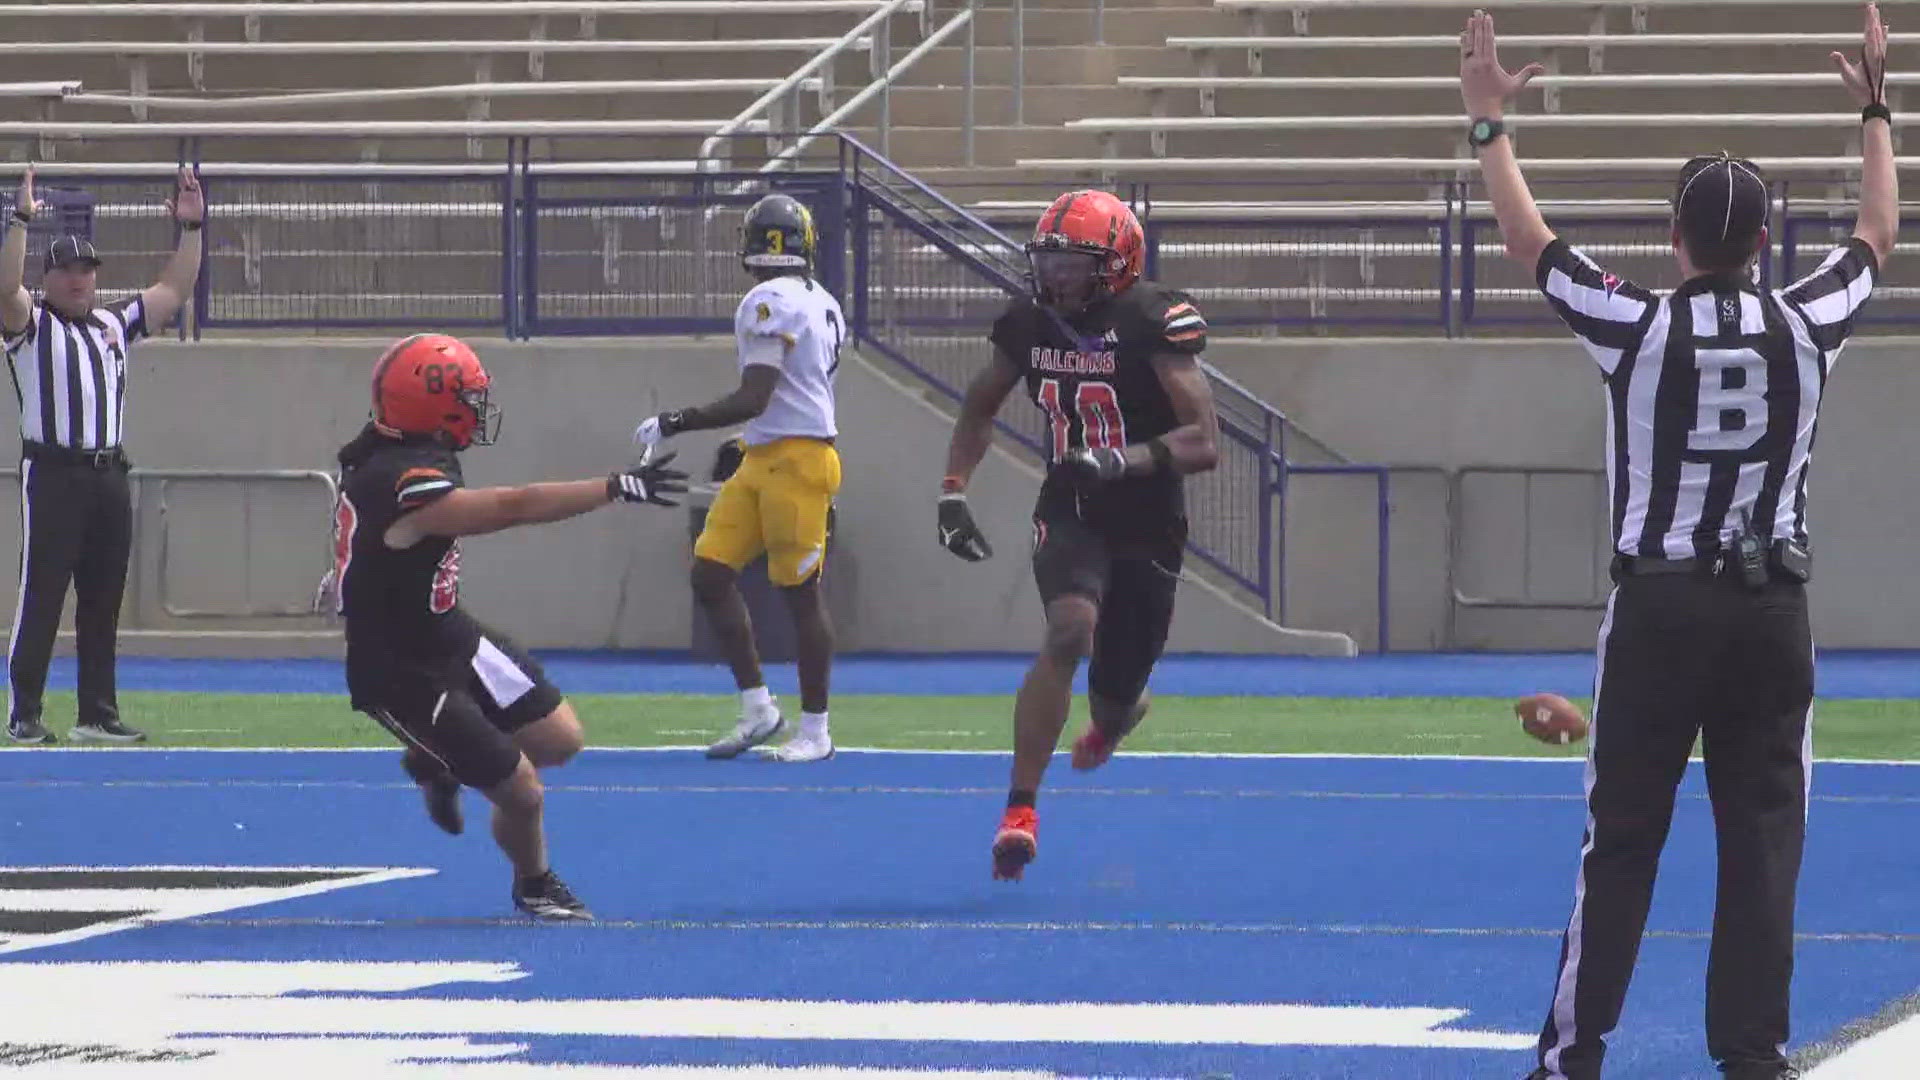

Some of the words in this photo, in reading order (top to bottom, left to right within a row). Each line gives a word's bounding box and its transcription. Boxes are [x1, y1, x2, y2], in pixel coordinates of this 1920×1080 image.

[766, 229, 783, 255] 3
[1031, 346, 1116, 374] FALCONS
[425, 363, 463, 395] 83
[1687, 347, 1769, 450] B
[1038, 377, 1127, 464] 10
